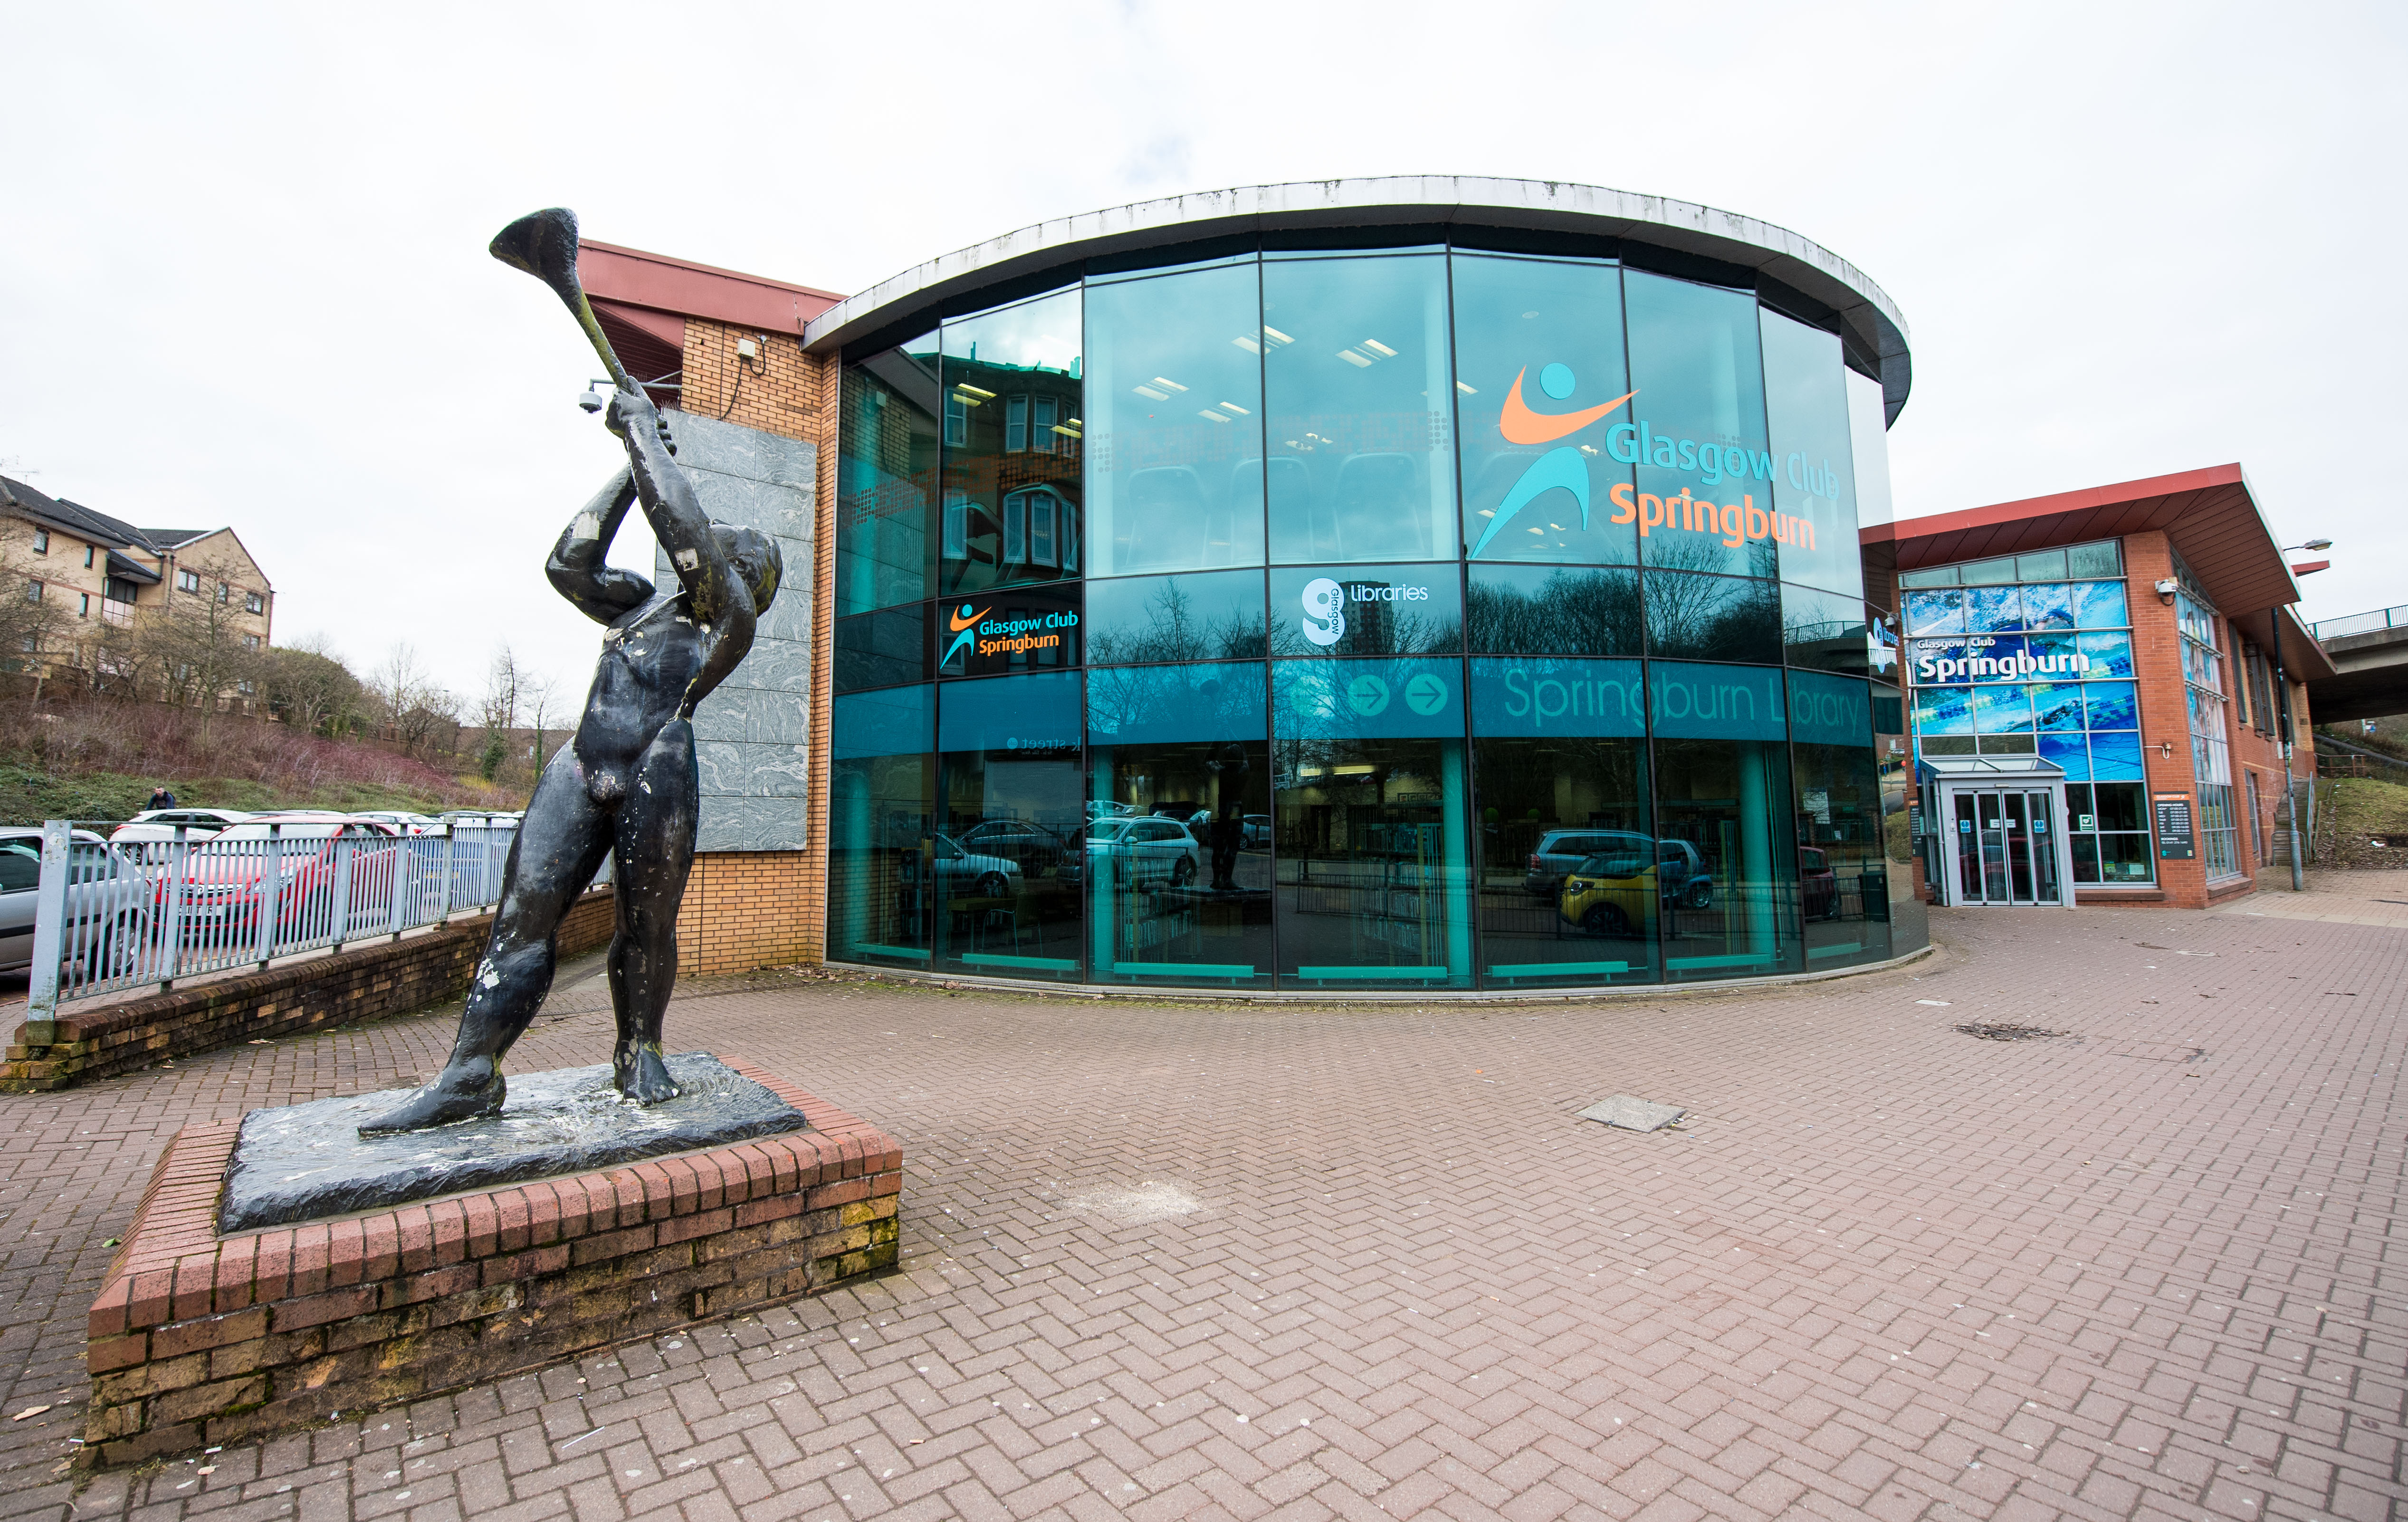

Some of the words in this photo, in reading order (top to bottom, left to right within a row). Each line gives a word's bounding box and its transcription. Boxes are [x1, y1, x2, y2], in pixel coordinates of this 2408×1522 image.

[1605, 421, 1779, 485] Glasgow
[1787, 450, 1840, 500] Club
[1609, 483, 1816, 550] Springburn
[1351, 584, 1429, 602] libraries
[979, 619, 1042, 636] Glasgow
[1045, 611, 1078, 628] Club
[1327, 588, 1339, 635] Glasgow
[979, 634, 1059, 657] Springburn
[1917, 639, 1966, 650] Glasgow
[1971, 637, 1996, 646] Club
[1919, 650, 2089, 681] Springburn
[1504, 669, 1754, 728] Springburn
[1769, 677, 1859, 737] Library
